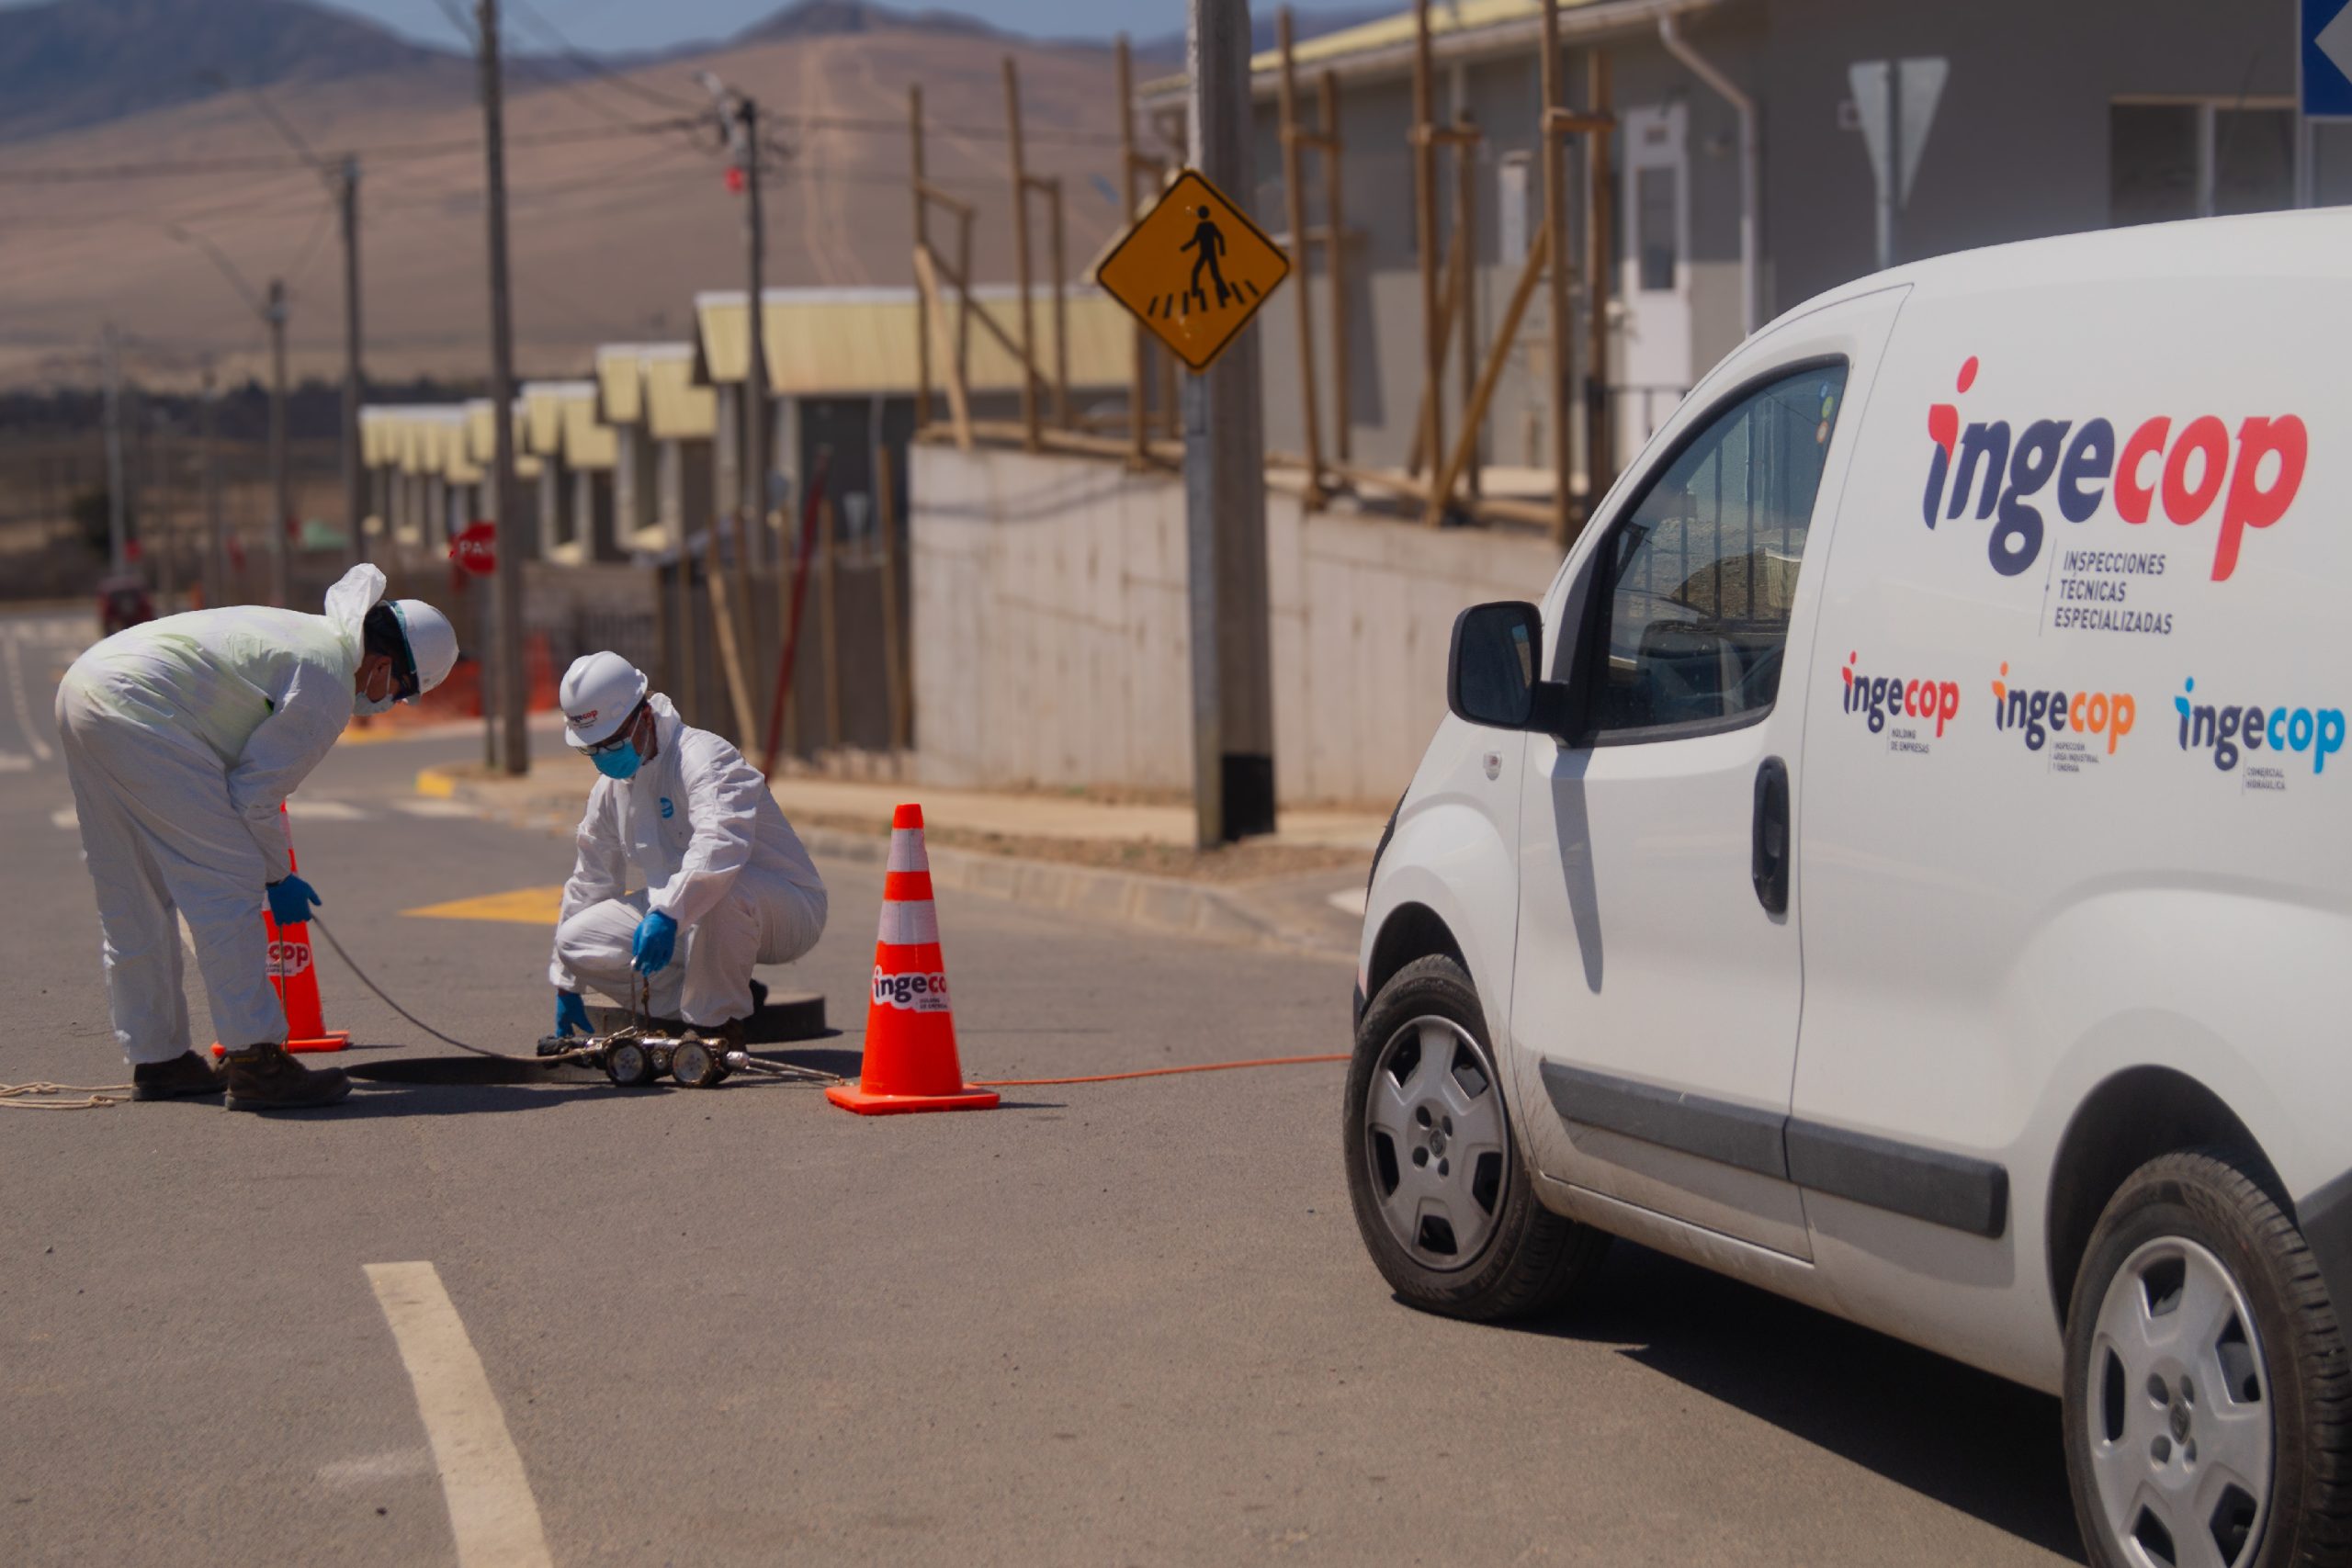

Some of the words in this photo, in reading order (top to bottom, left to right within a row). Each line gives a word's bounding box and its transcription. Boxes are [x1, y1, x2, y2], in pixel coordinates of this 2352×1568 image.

[1923, 355, 2308, 581] ingecop
[2064, 550, 2165, 575] INSPECCIONES
[2054, 606, 2173, 635] ESPECIALIZADAS
[1842, 650, 1960, 738] ingecop
[1992, 661, 2135, 754] ingecop
[2175, 676, 2346, 774] ingecop
[874, 968, 947, 1003] ingeco
